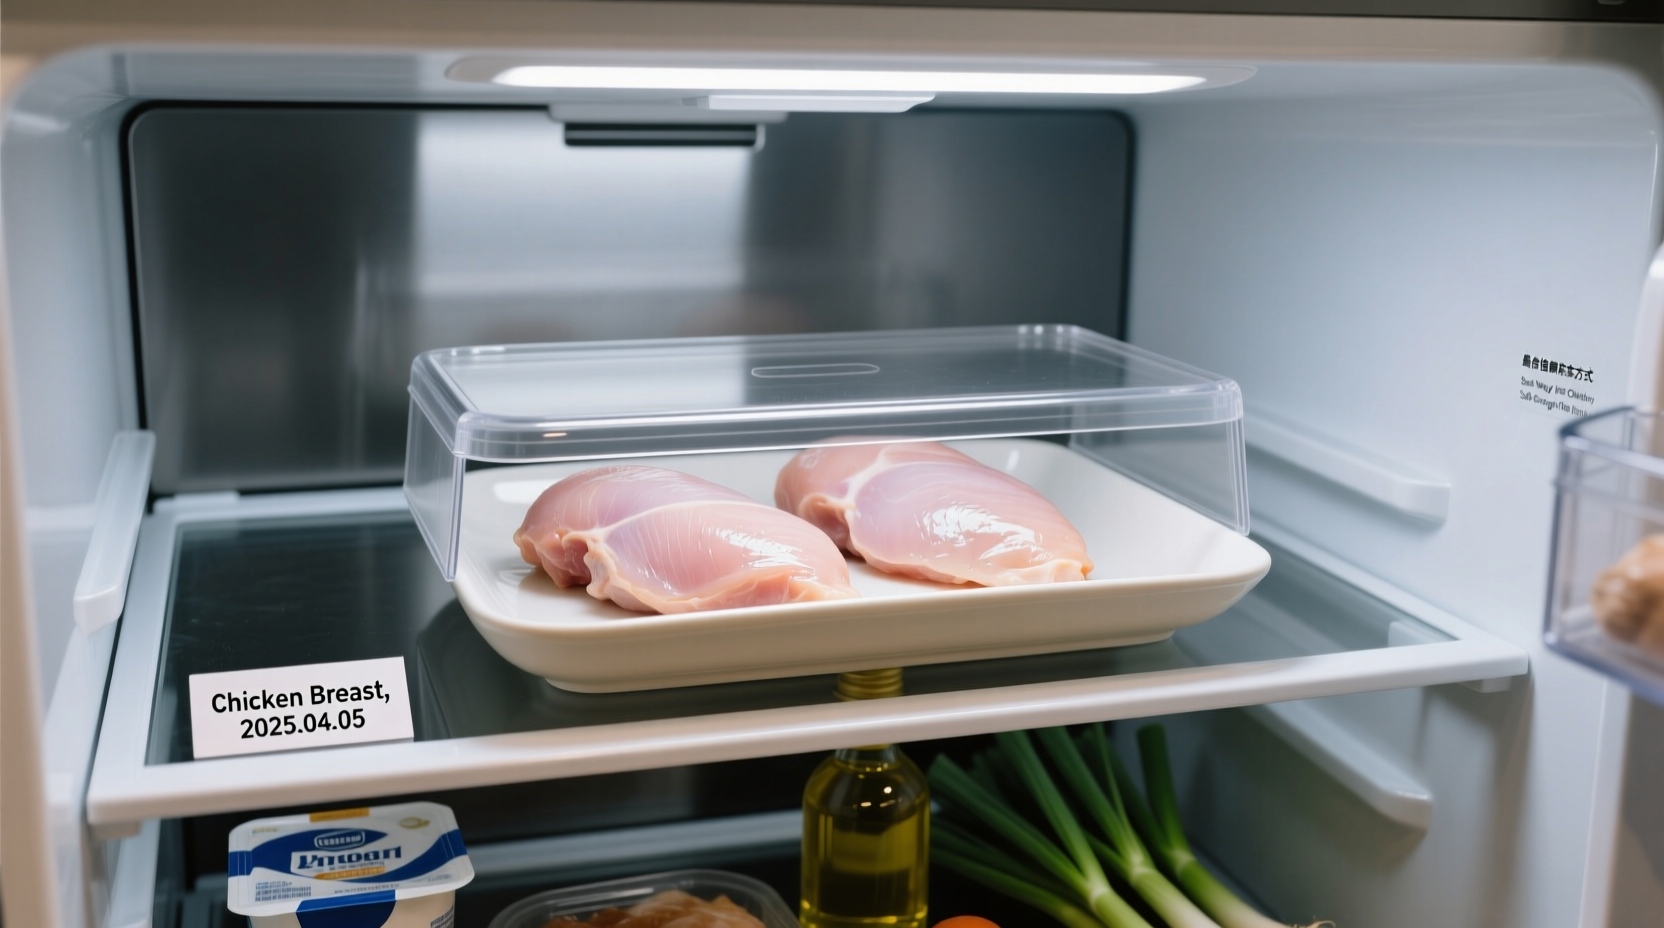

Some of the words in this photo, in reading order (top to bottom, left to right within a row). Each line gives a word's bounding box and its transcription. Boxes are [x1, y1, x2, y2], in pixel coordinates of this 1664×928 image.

[212, 689, 303, 713] Chicken
[310, 680, 389, 705] Breast,
[241, 708, 366, 738] 2025.04.05
